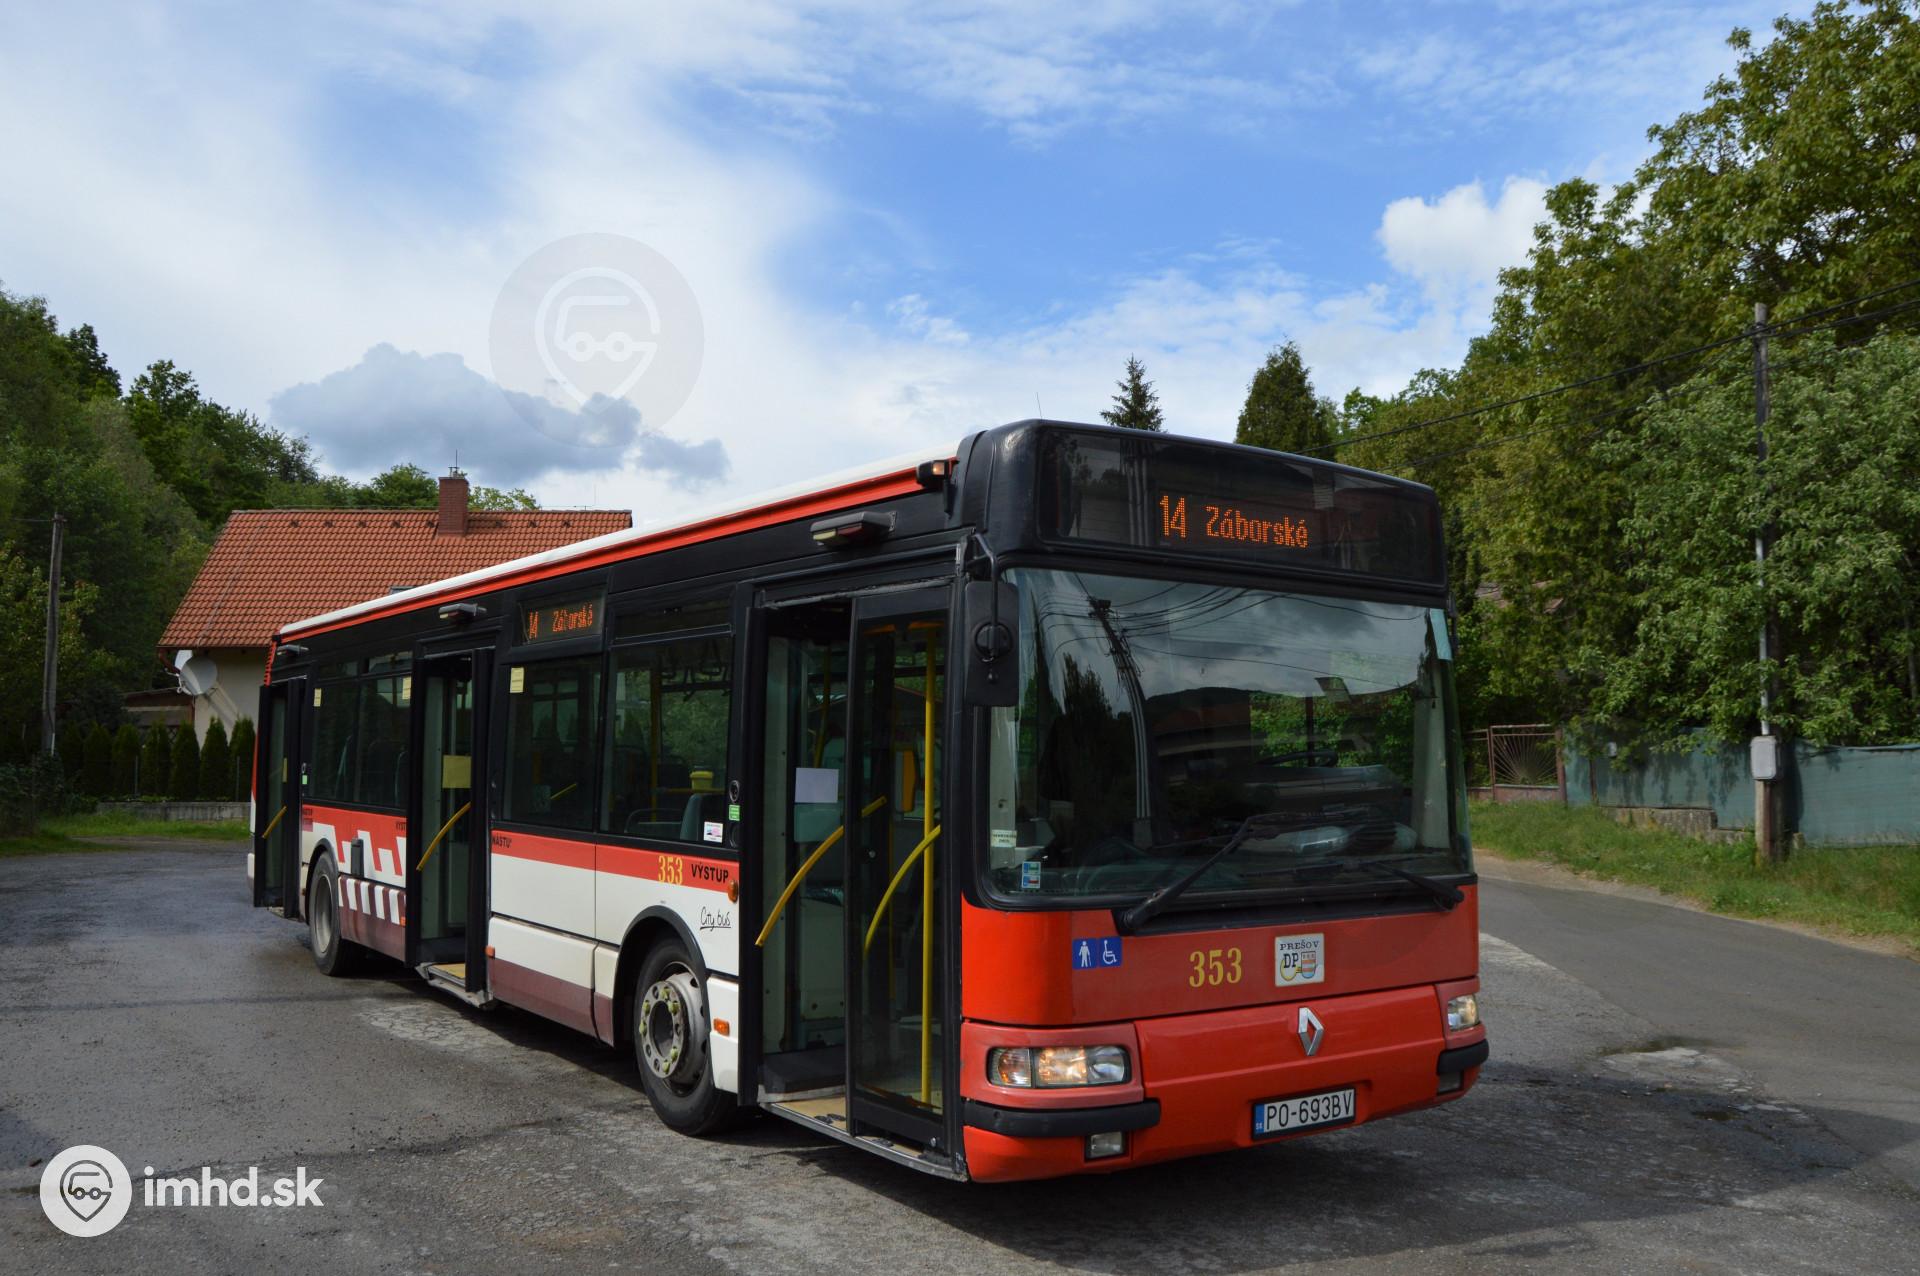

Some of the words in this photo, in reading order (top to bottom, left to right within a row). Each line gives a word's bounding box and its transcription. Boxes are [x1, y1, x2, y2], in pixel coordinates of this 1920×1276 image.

[1160, 496, 1187, 538] 14
[1204, 505, 1309, 548] Záborské
[658, 855, 683, 885] 353
[691, 861, 729, 883] VÝSTUP
[700, 906, 715, 932] City
[717, 908, 731, 927] bus
[1279, 939, 1320, 951] PREŠOV
[1189, 947, 1242, 988] 353
[1283, 952, 1299, 969] DP
[1266, 1091, 1353, 1130] PO-693BV
